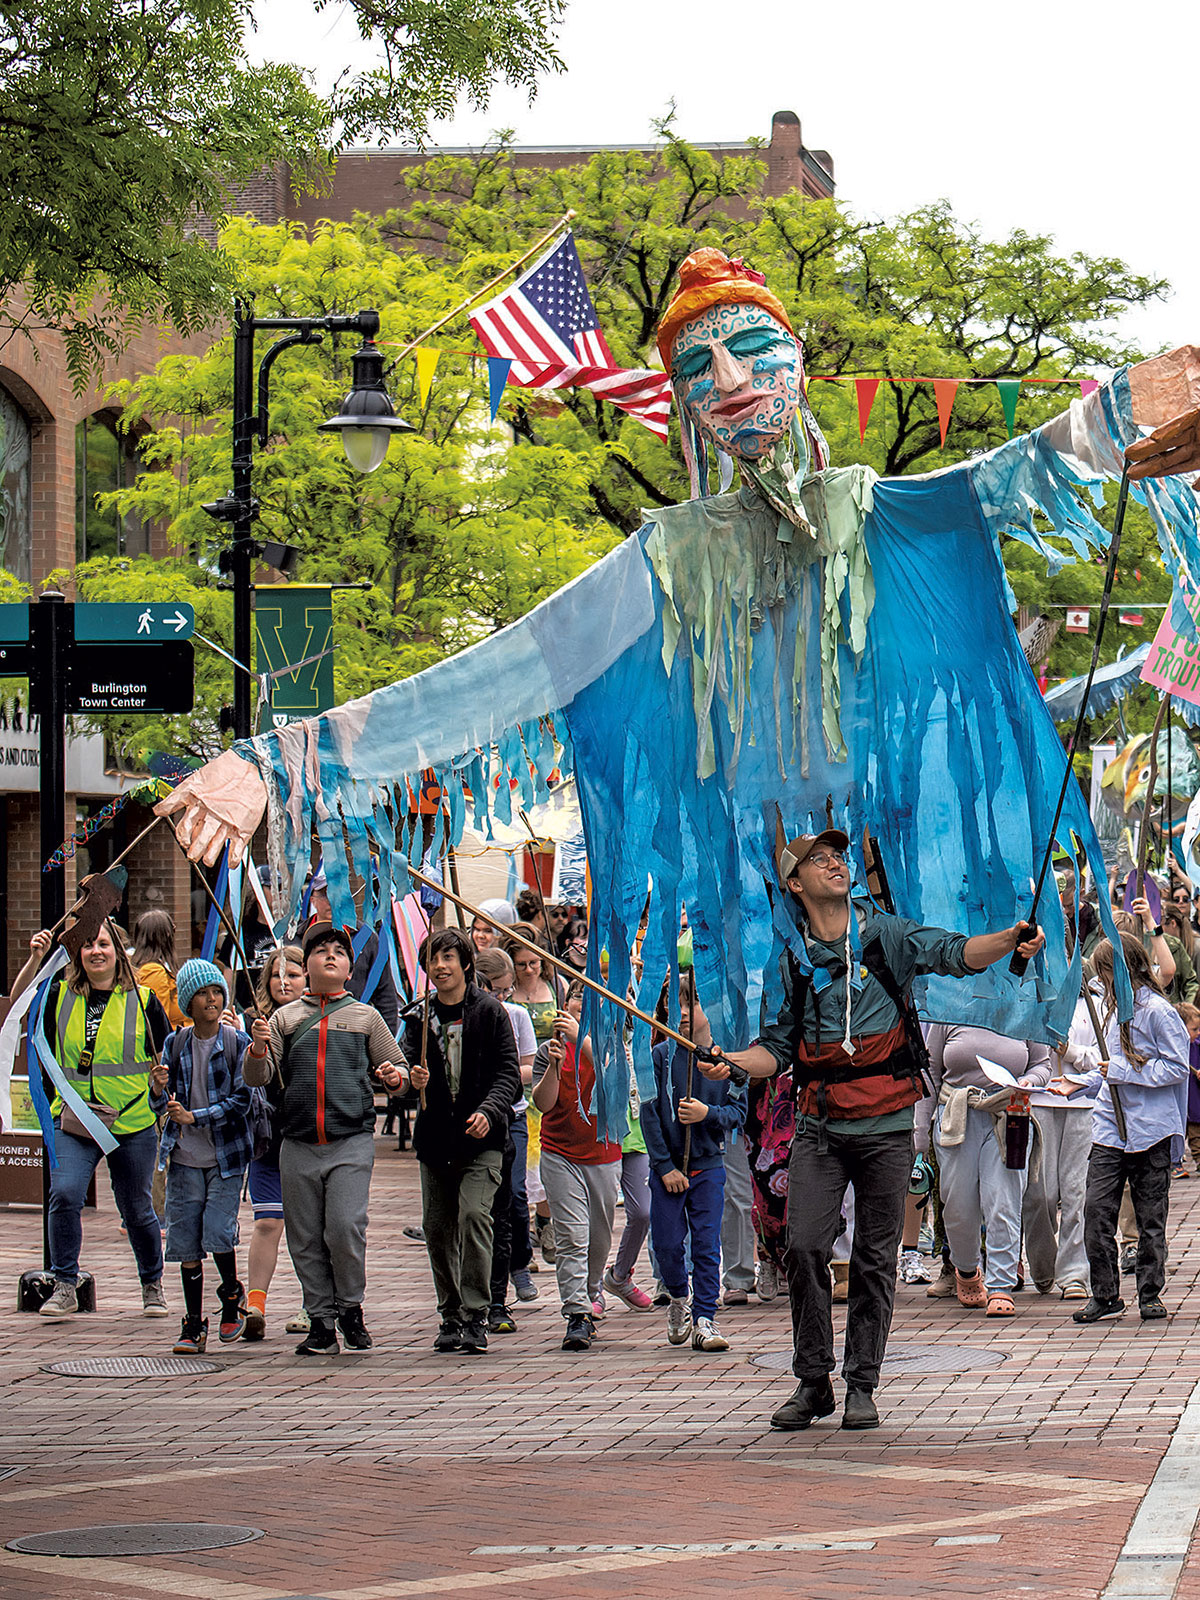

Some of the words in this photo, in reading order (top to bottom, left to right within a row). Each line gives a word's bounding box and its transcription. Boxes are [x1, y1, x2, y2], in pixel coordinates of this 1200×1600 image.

[92, 682, 147, 696] Burlington
[79, 696, 108, 707] Town
[111, 697, 146, 707] Center
[5, 747, 20, 766] AND
